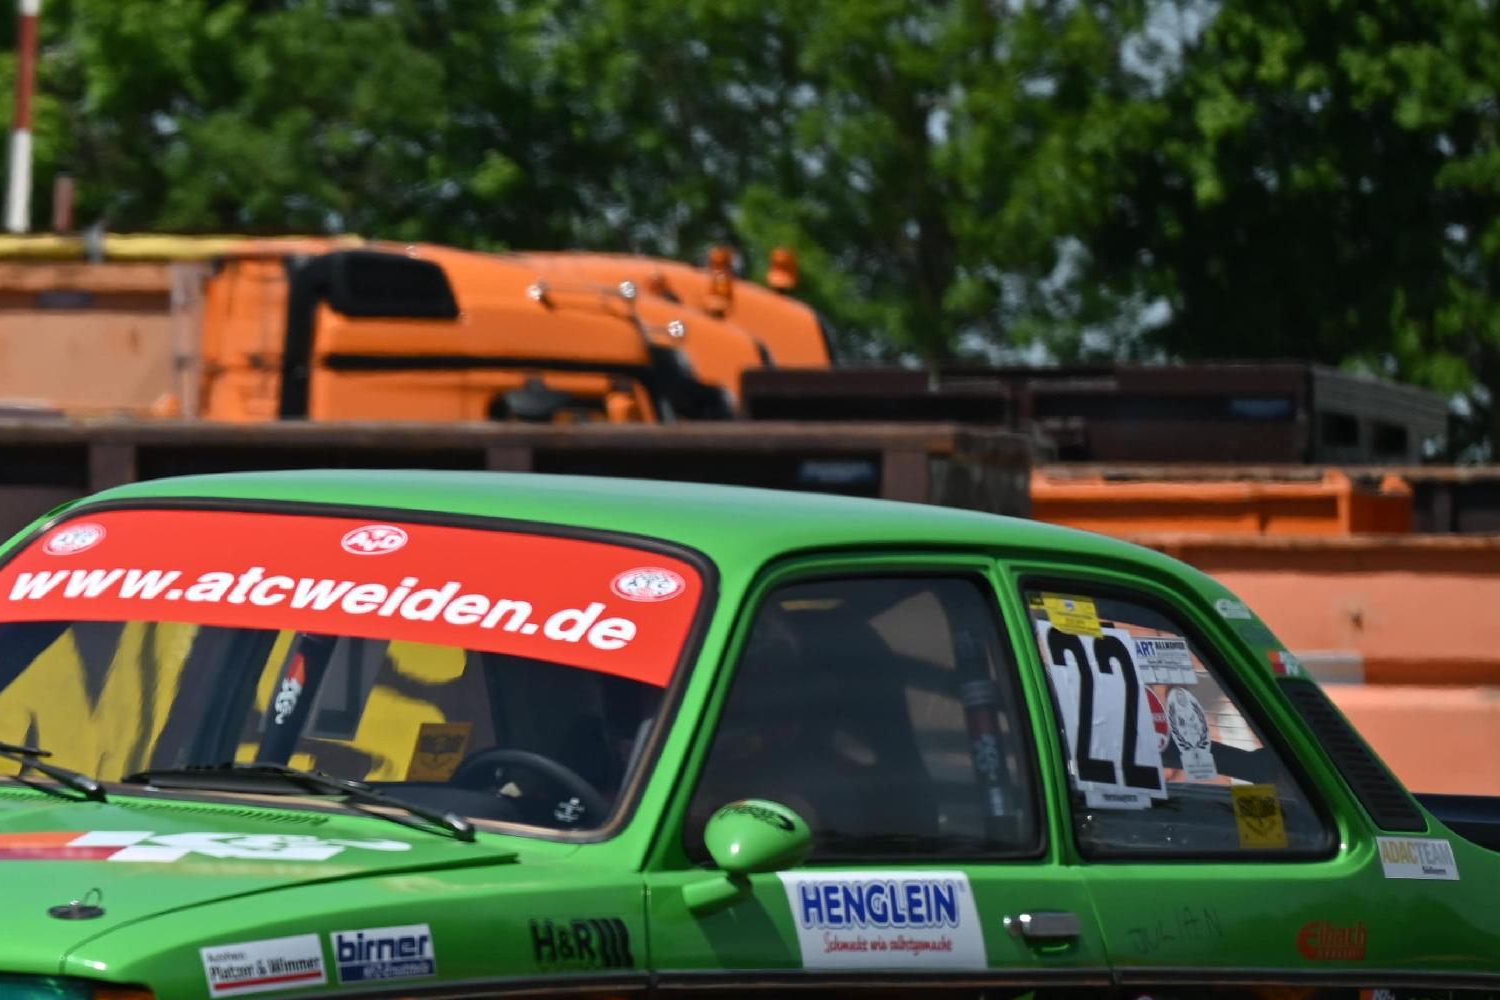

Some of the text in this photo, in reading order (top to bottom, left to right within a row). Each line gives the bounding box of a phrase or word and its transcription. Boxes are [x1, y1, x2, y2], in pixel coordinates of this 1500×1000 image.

[8, 566, 638, 650] www.atcweiden.de
[1047, 624, 1162, 790] 22
[799, 881, 959, 927] HENGLEIN
[337, 933, 429, 962] birner
